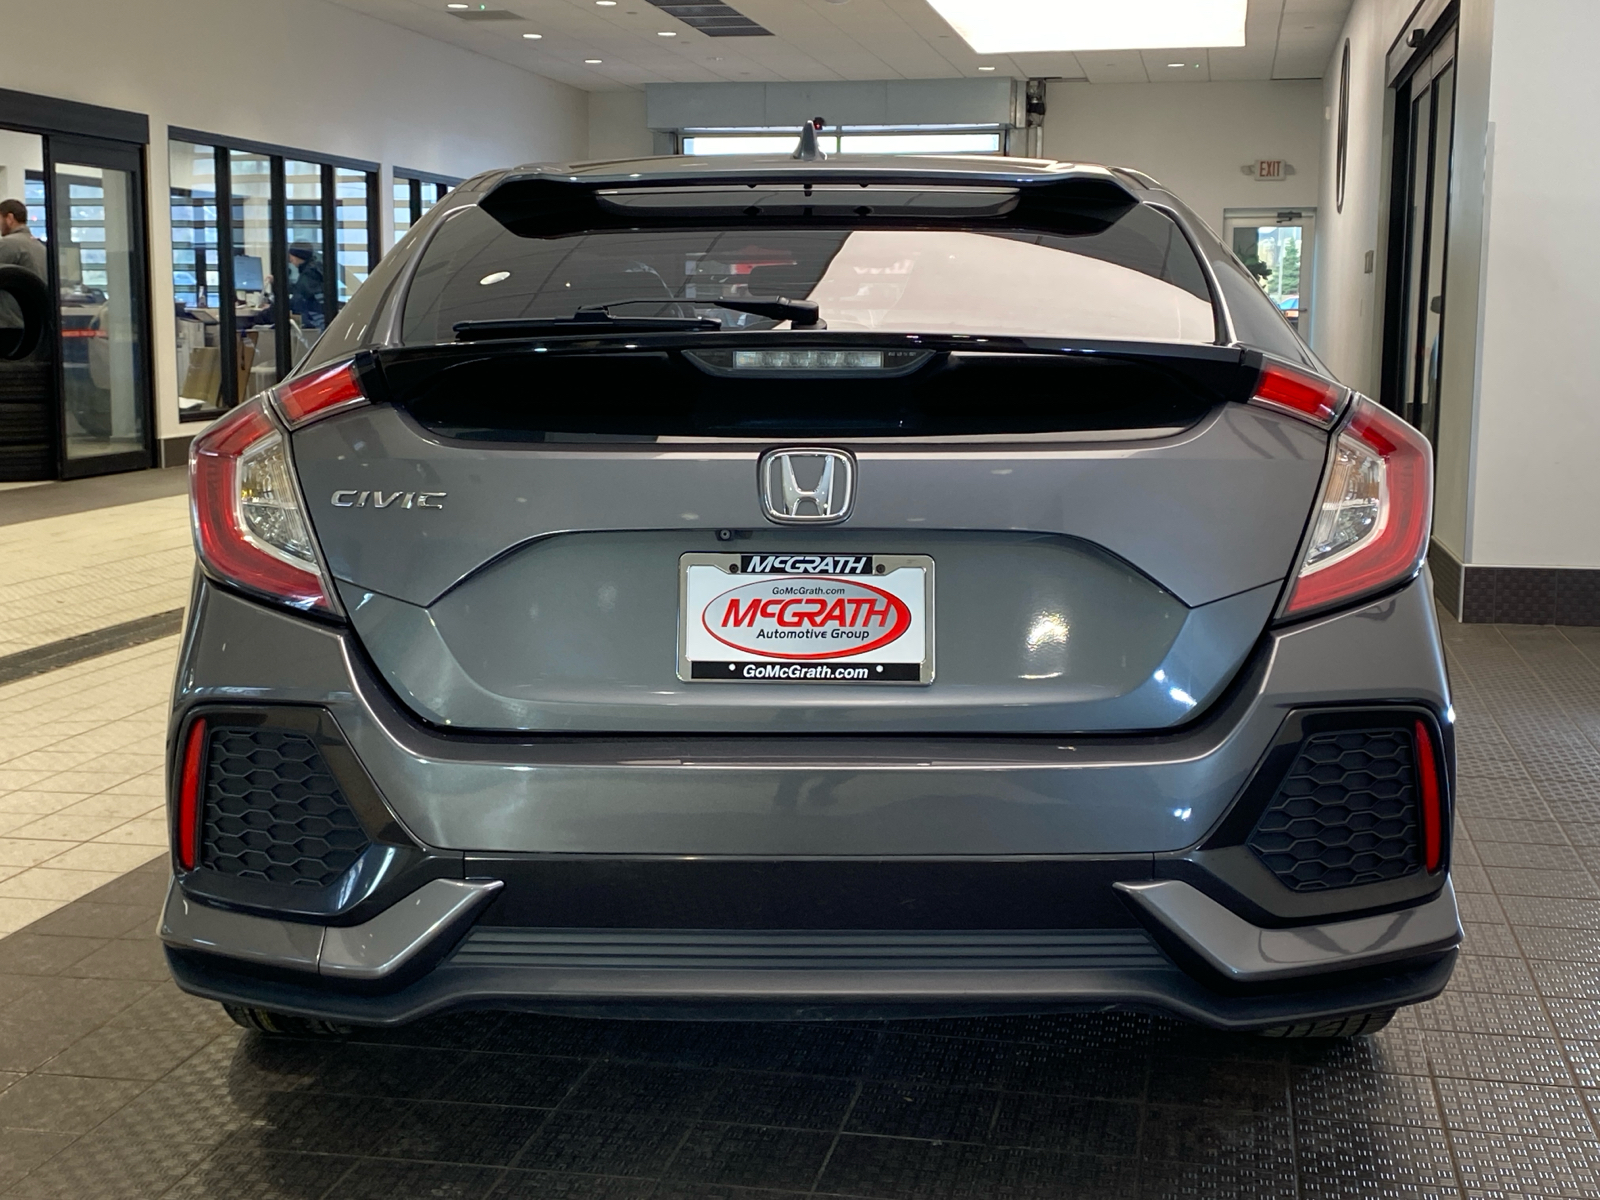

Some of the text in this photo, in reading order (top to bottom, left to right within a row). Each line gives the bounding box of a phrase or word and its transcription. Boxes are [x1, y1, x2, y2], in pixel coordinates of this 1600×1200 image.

[1259, 161, 1282, 177] EXIT
[330, 490, 447, 510] CIVIC
[772, 586, 846, 596] GoMcGrath.com
[756, 628, 870, 641] Automotive Group
[743, 664, 869, 679] GoMcGrath.com
